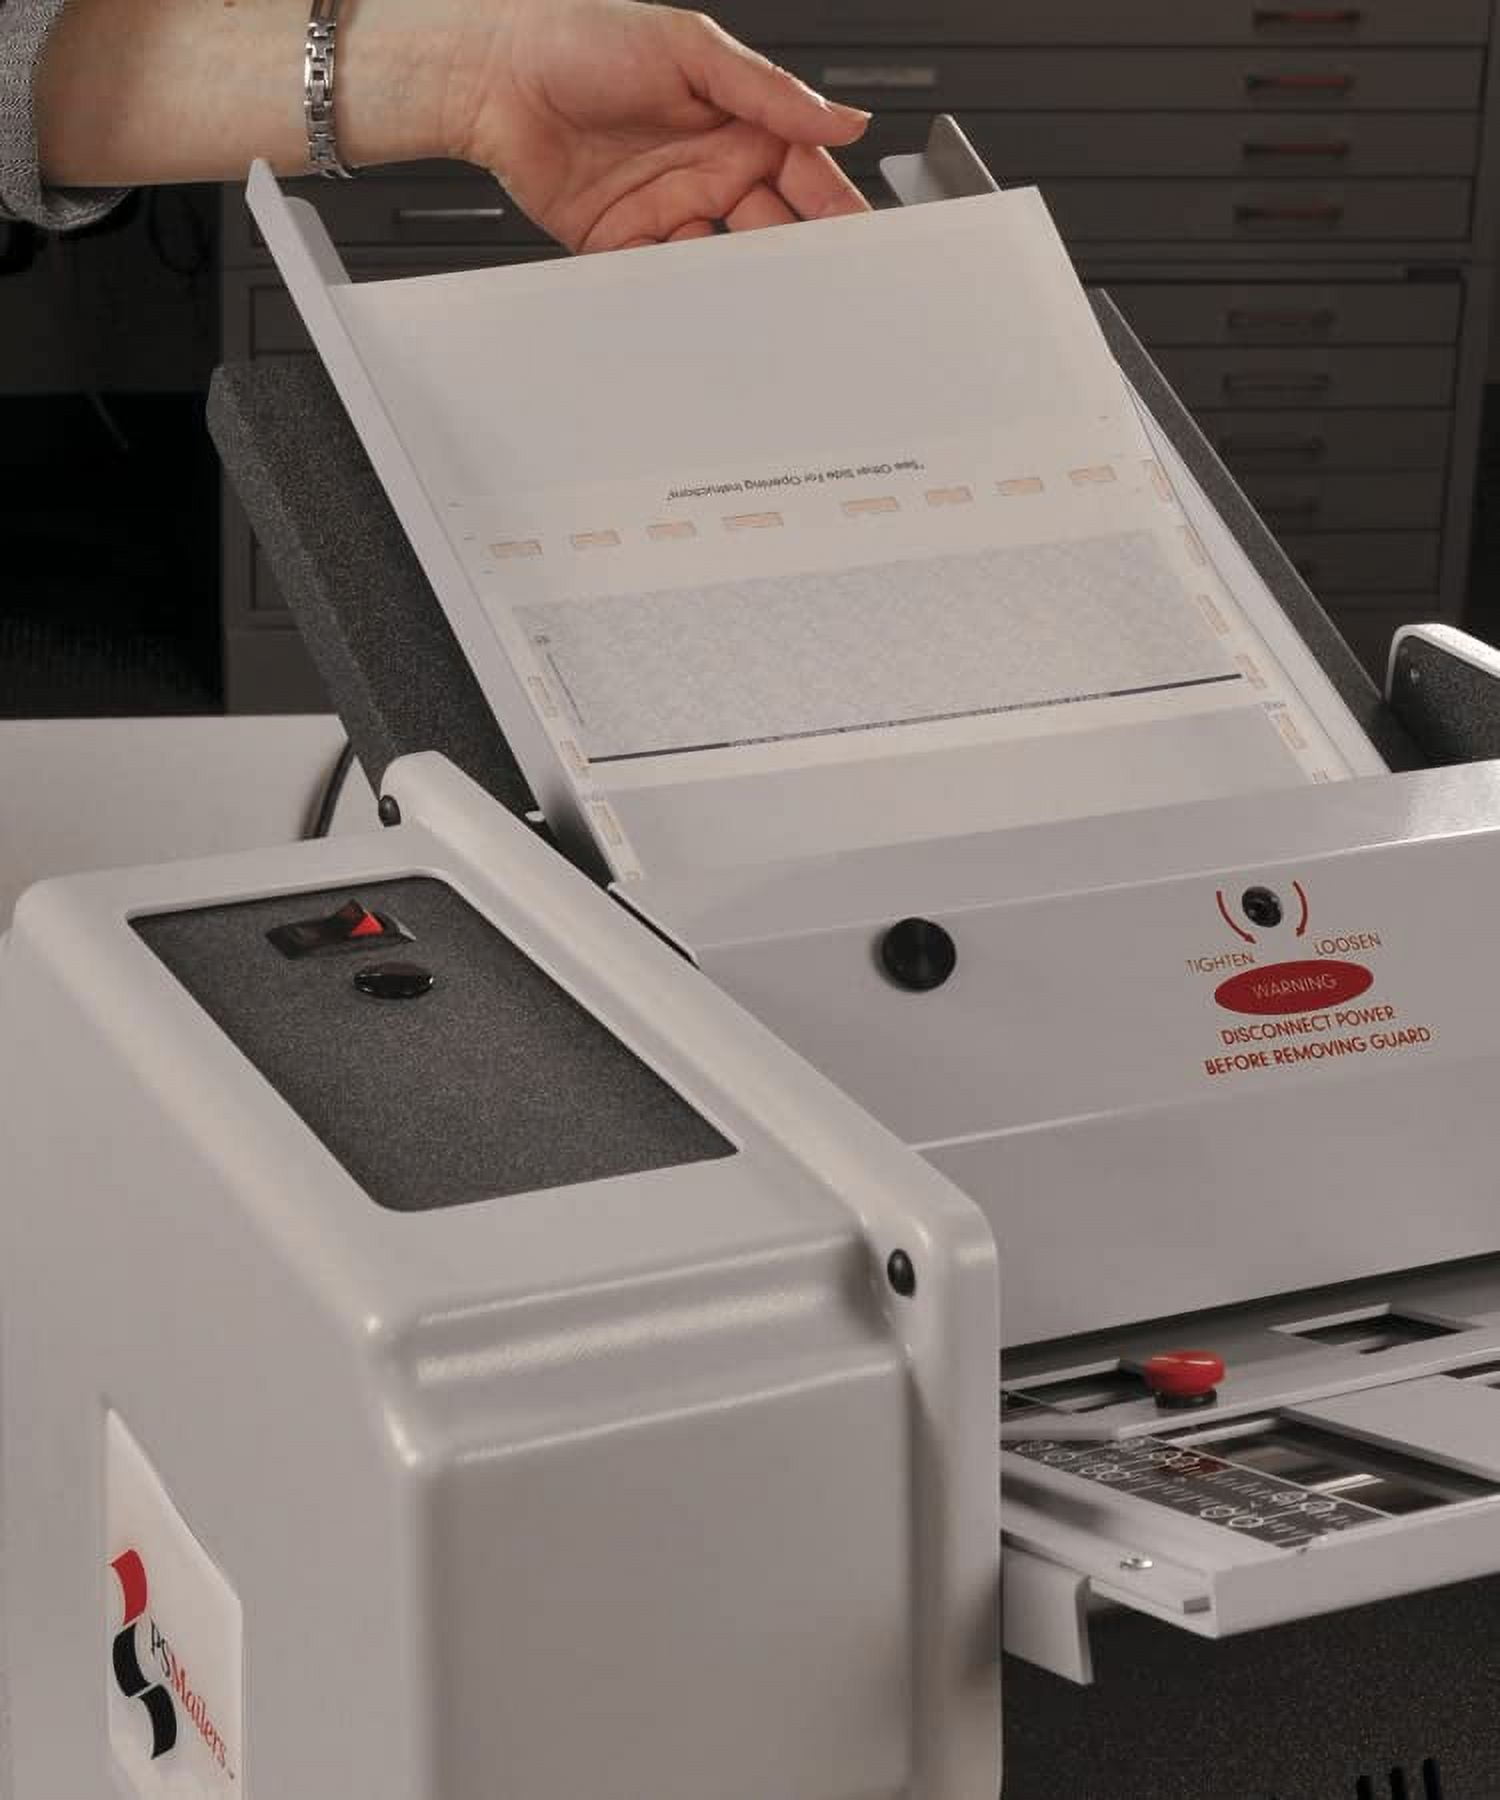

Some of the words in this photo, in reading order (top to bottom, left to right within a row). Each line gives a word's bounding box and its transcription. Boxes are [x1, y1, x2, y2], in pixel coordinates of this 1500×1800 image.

[826, 468, 855, 480] Side
[856, 463, 892, 475] Other
[744, 474, 801, 490] Opening
[1315, 931, 1382, 957] LOOSEN
[1186, 951, 1255, 975] TIGHTEN
[1252, 973, 1338, 999] WARNING
[1220, 1014, 1333, 1046] DISCONNECT
[1336, 1004, 1396, 1028] POWER
[1204, 1049, 1271, 1076] BEFORE
[1274, 1036, 1367, 1065] REMOVING
[1370, 1026, 1431, 1051] GUARD
